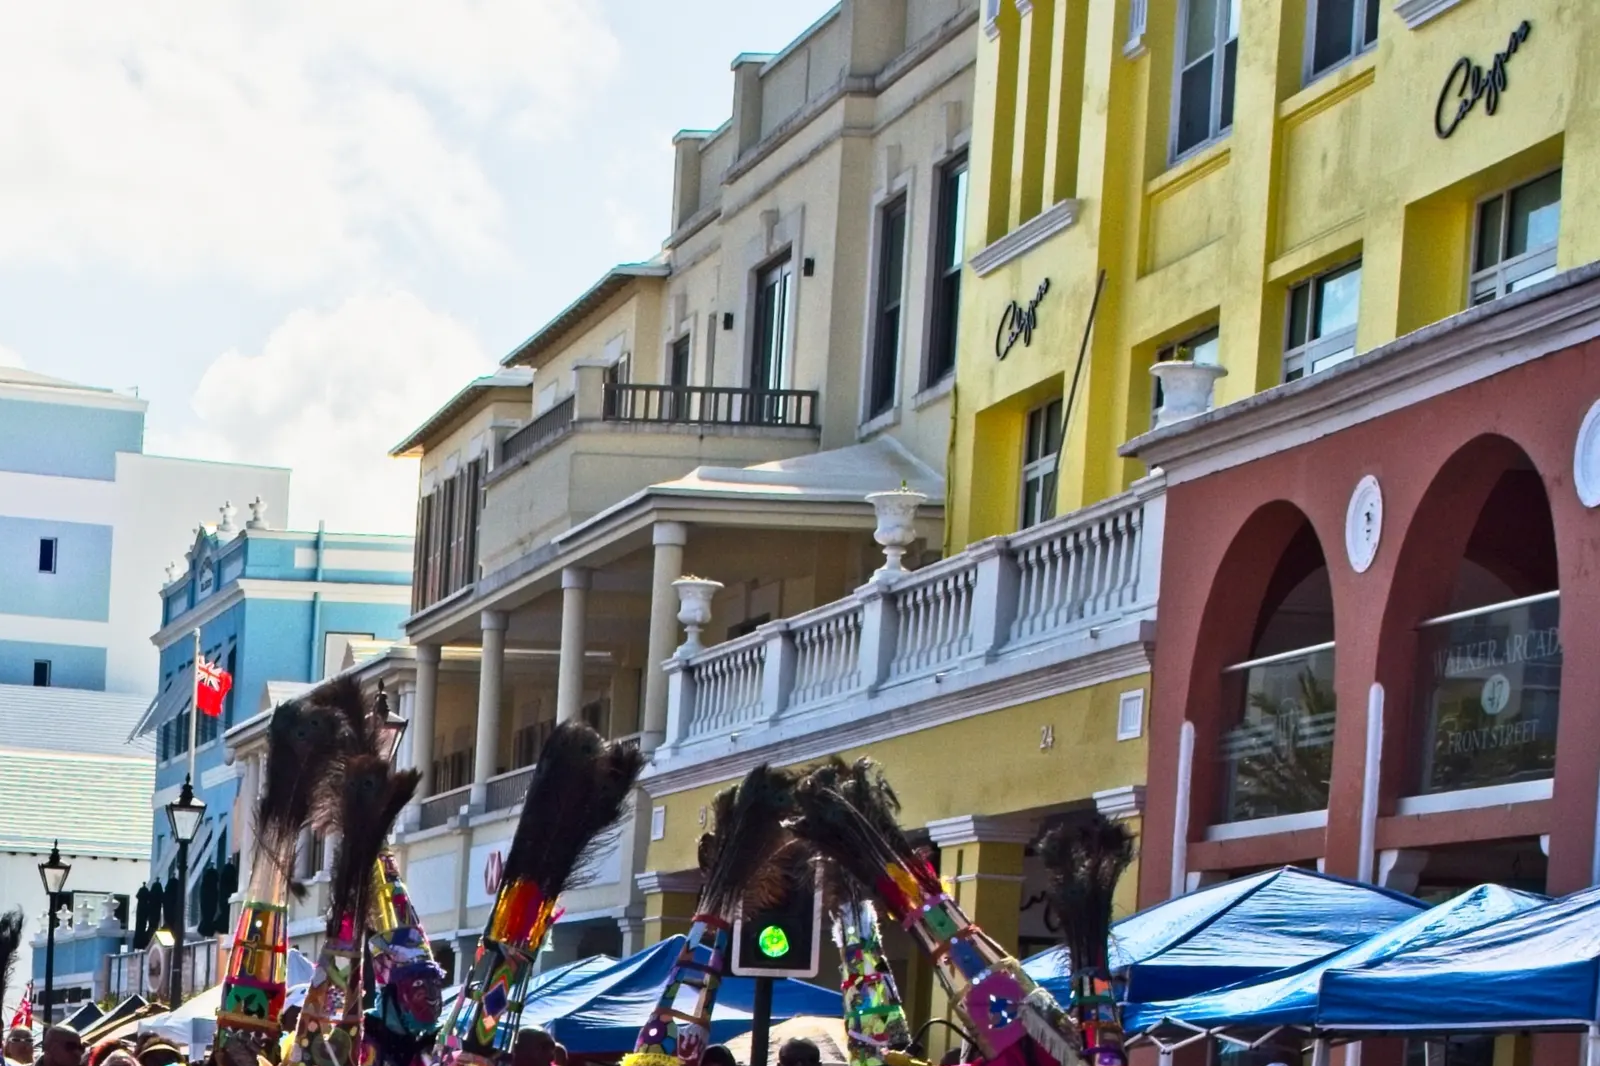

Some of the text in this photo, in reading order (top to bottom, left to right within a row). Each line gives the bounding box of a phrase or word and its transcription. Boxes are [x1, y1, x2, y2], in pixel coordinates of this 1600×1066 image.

[1433, 640, 1501, 677] WALKER
[1448, 719, 1540, 754] FRONT STREET
